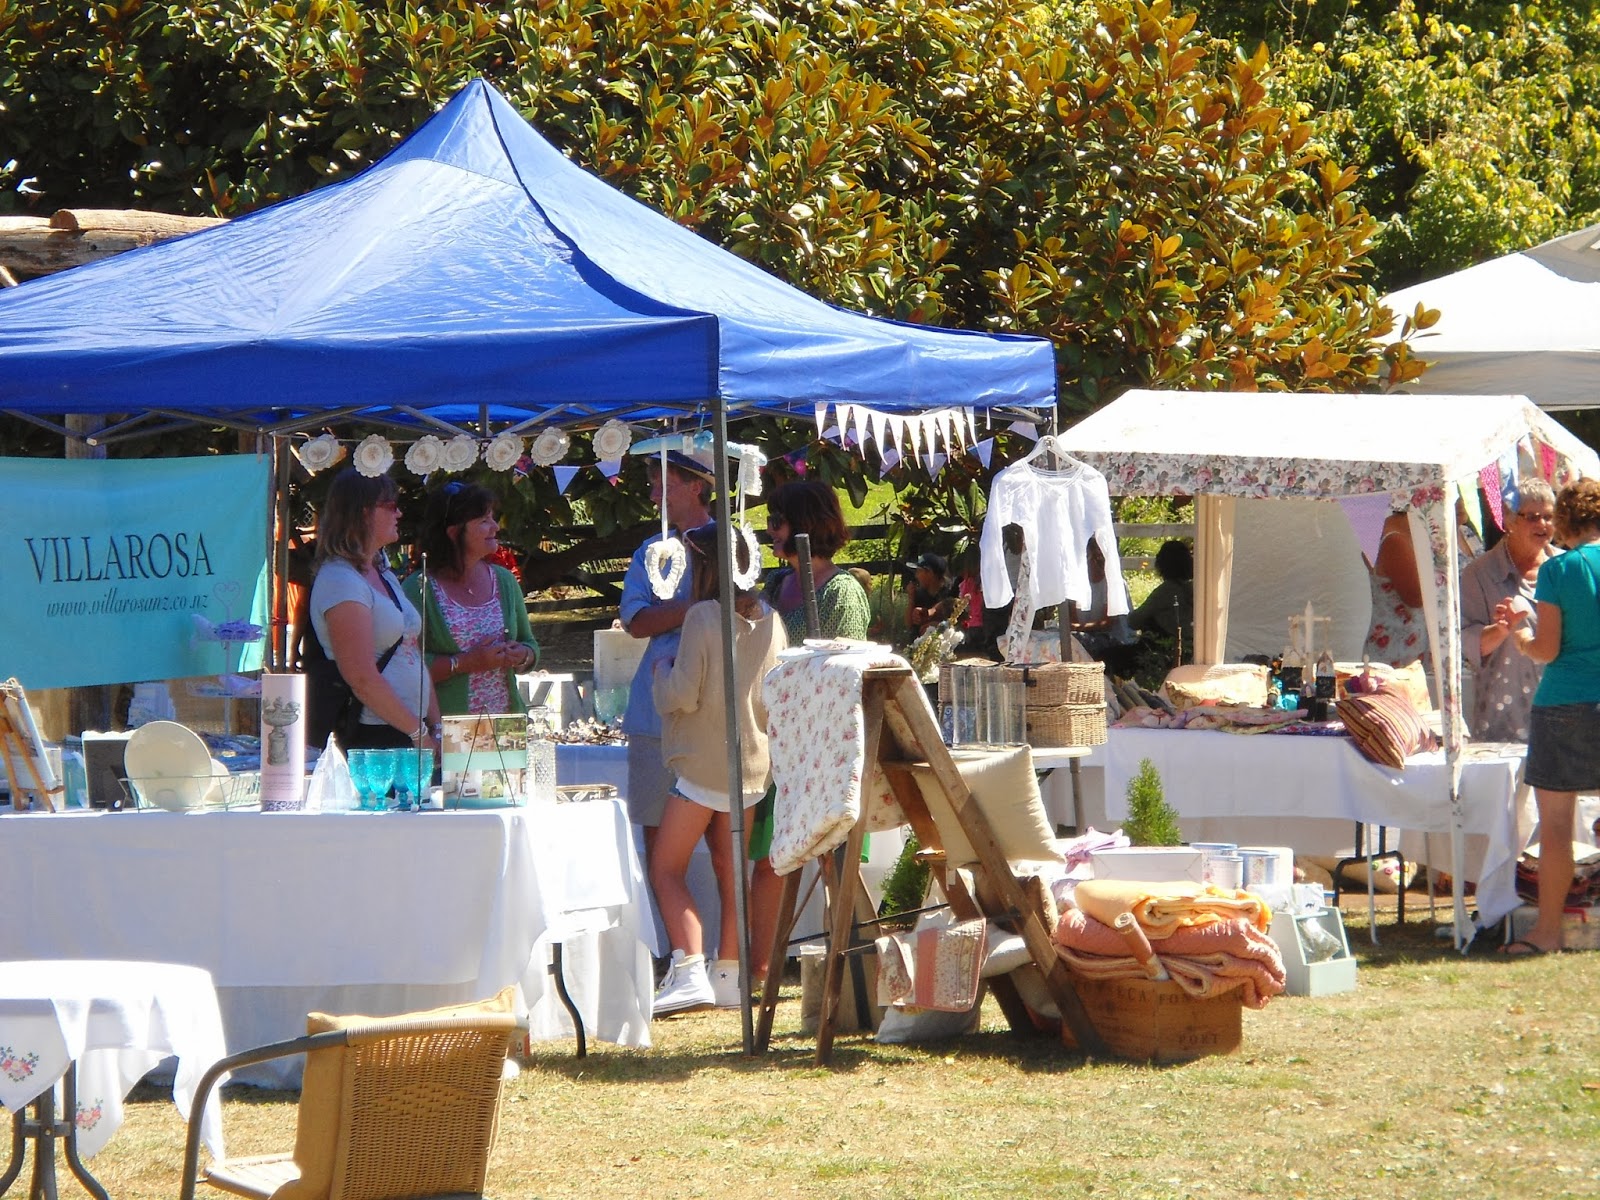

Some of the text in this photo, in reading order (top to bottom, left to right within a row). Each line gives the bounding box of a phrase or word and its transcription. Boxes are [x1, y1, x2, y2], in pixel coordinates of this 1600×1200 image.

[24, 533, 215, 583] VILLAROSA
[46, 587, 209, 617] www.villarosanz.co.nz
[1178, 1032, 1219, 1045] PORT
